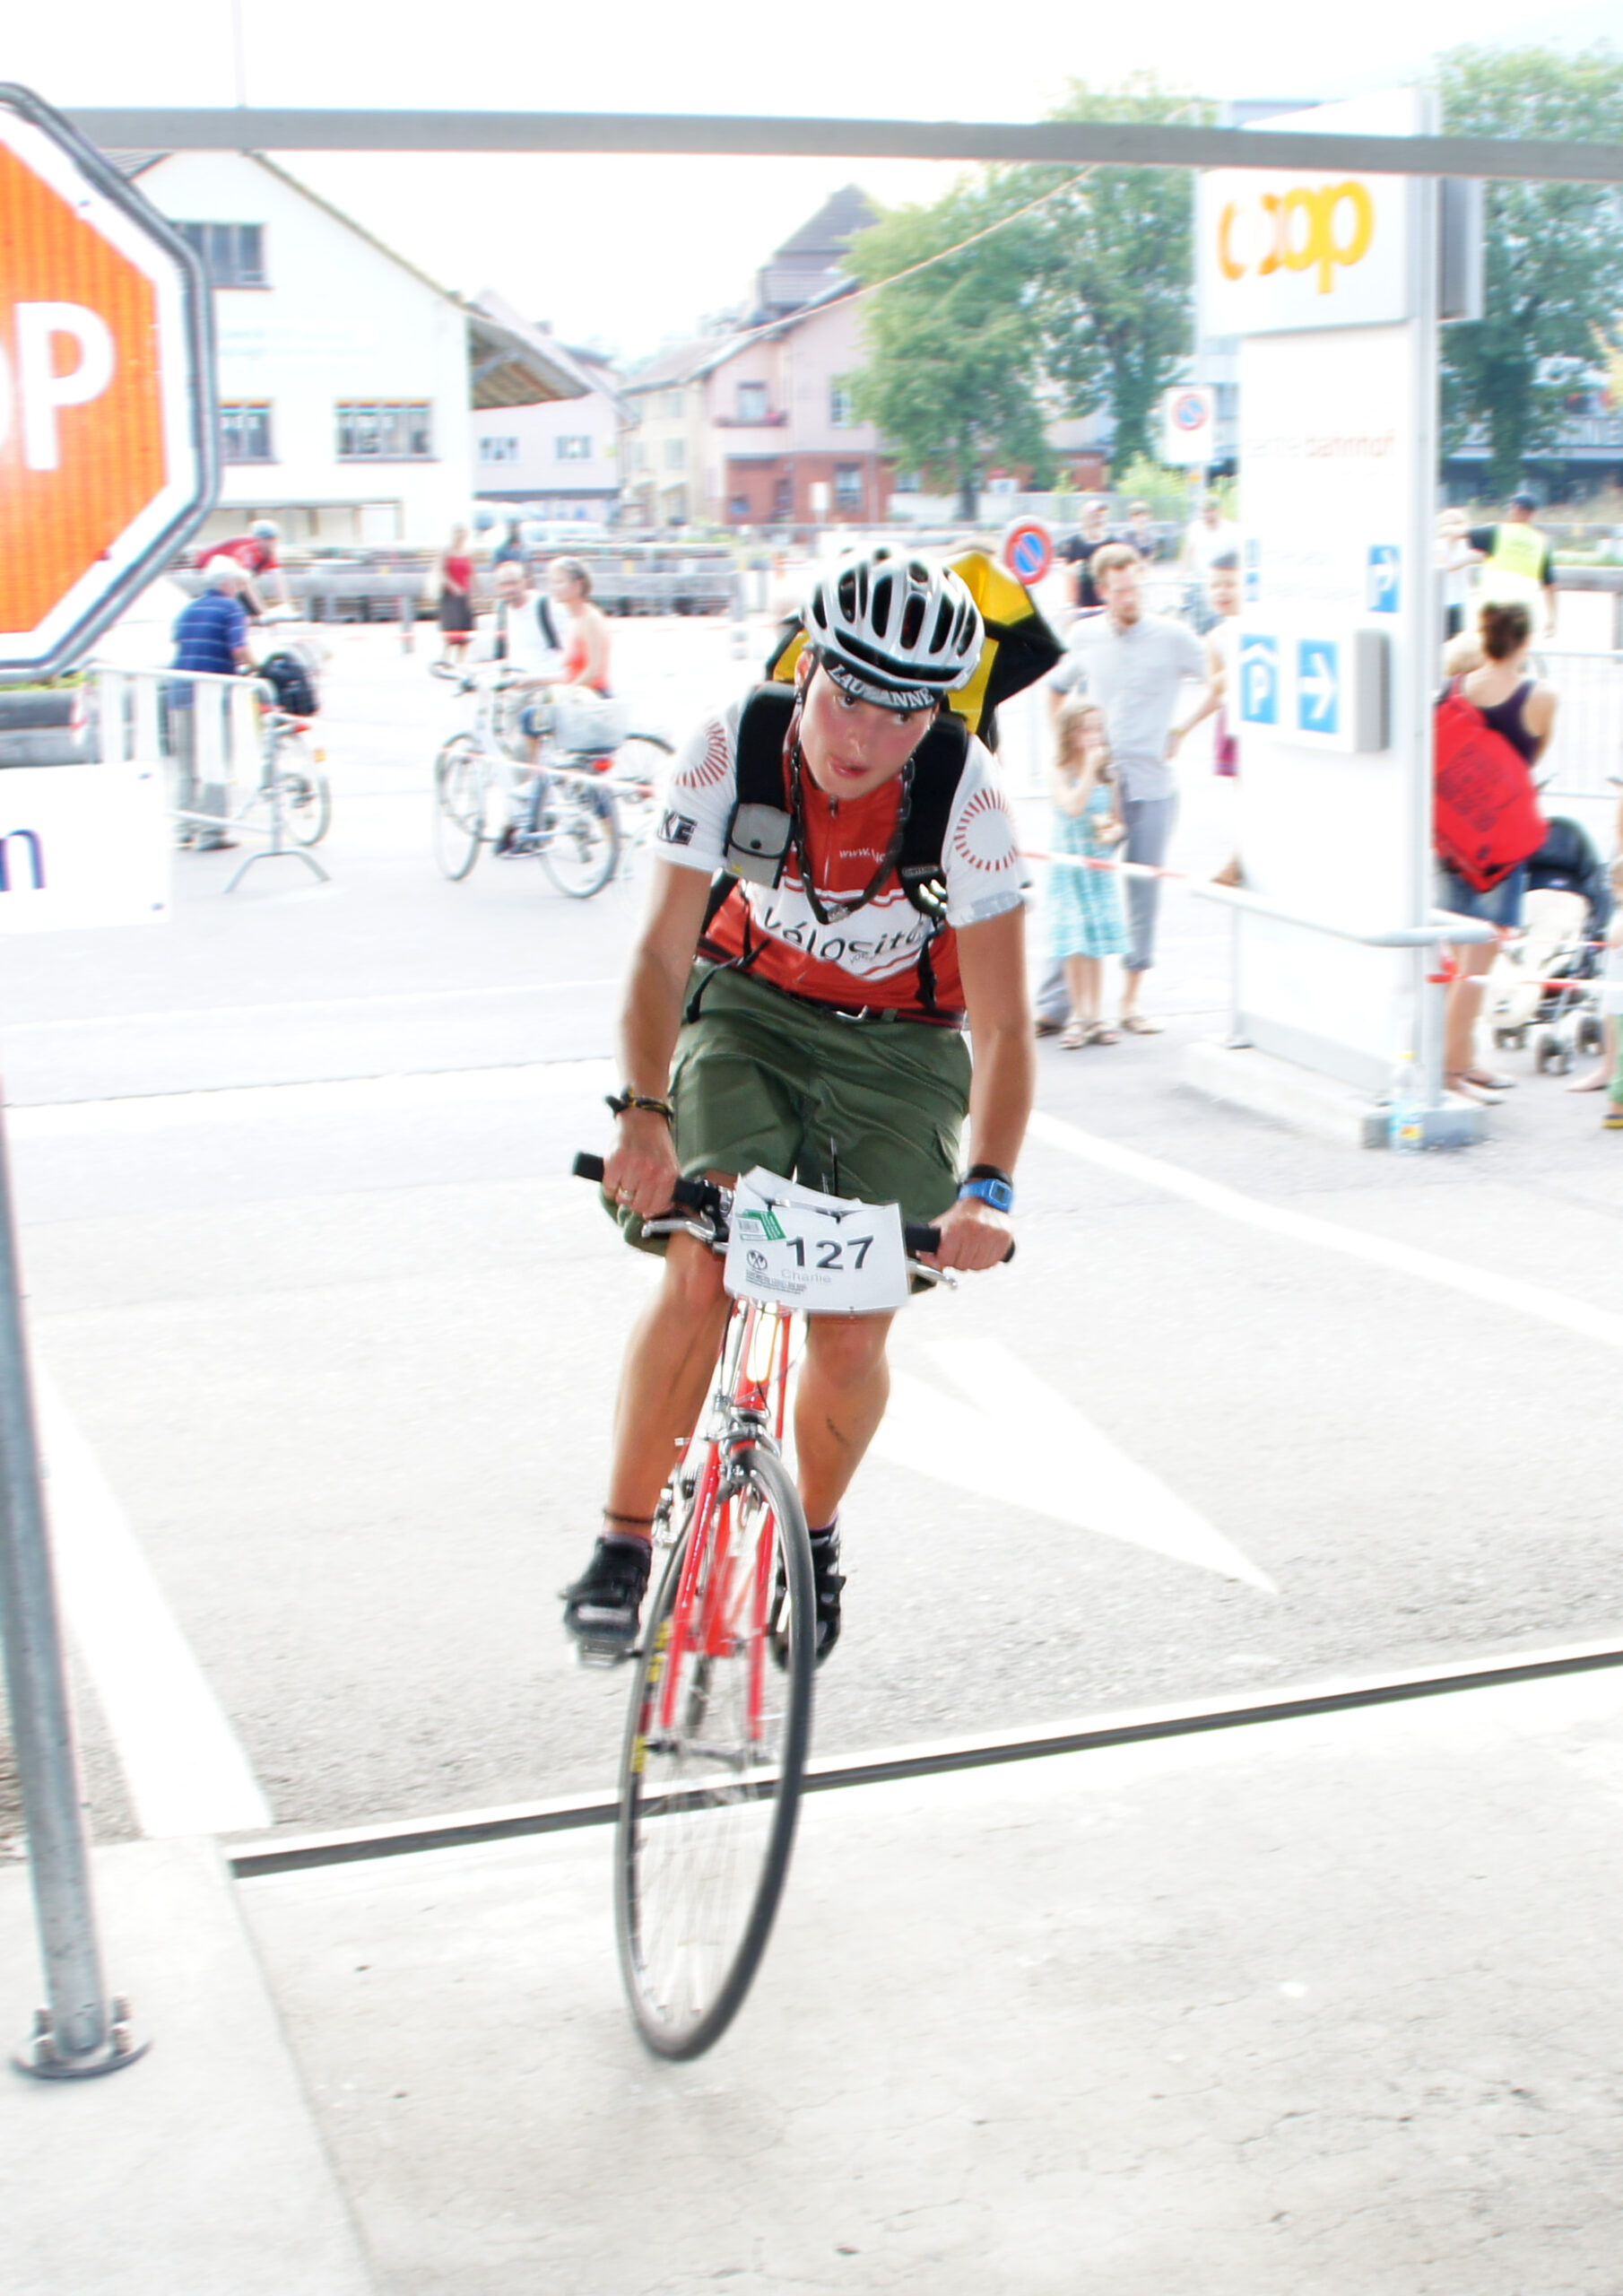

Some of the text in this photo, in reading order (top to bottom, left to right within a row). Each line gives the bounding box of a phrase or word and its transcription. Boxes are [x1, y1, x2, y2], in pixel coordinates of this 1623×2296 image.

[1306, 428, 1395, 459] bahnhof
[828, 664, 934, 708] LAUANNE
[785, 1235, 874, 1270] 127
[781, 1269, 832, 1283] Charlie
